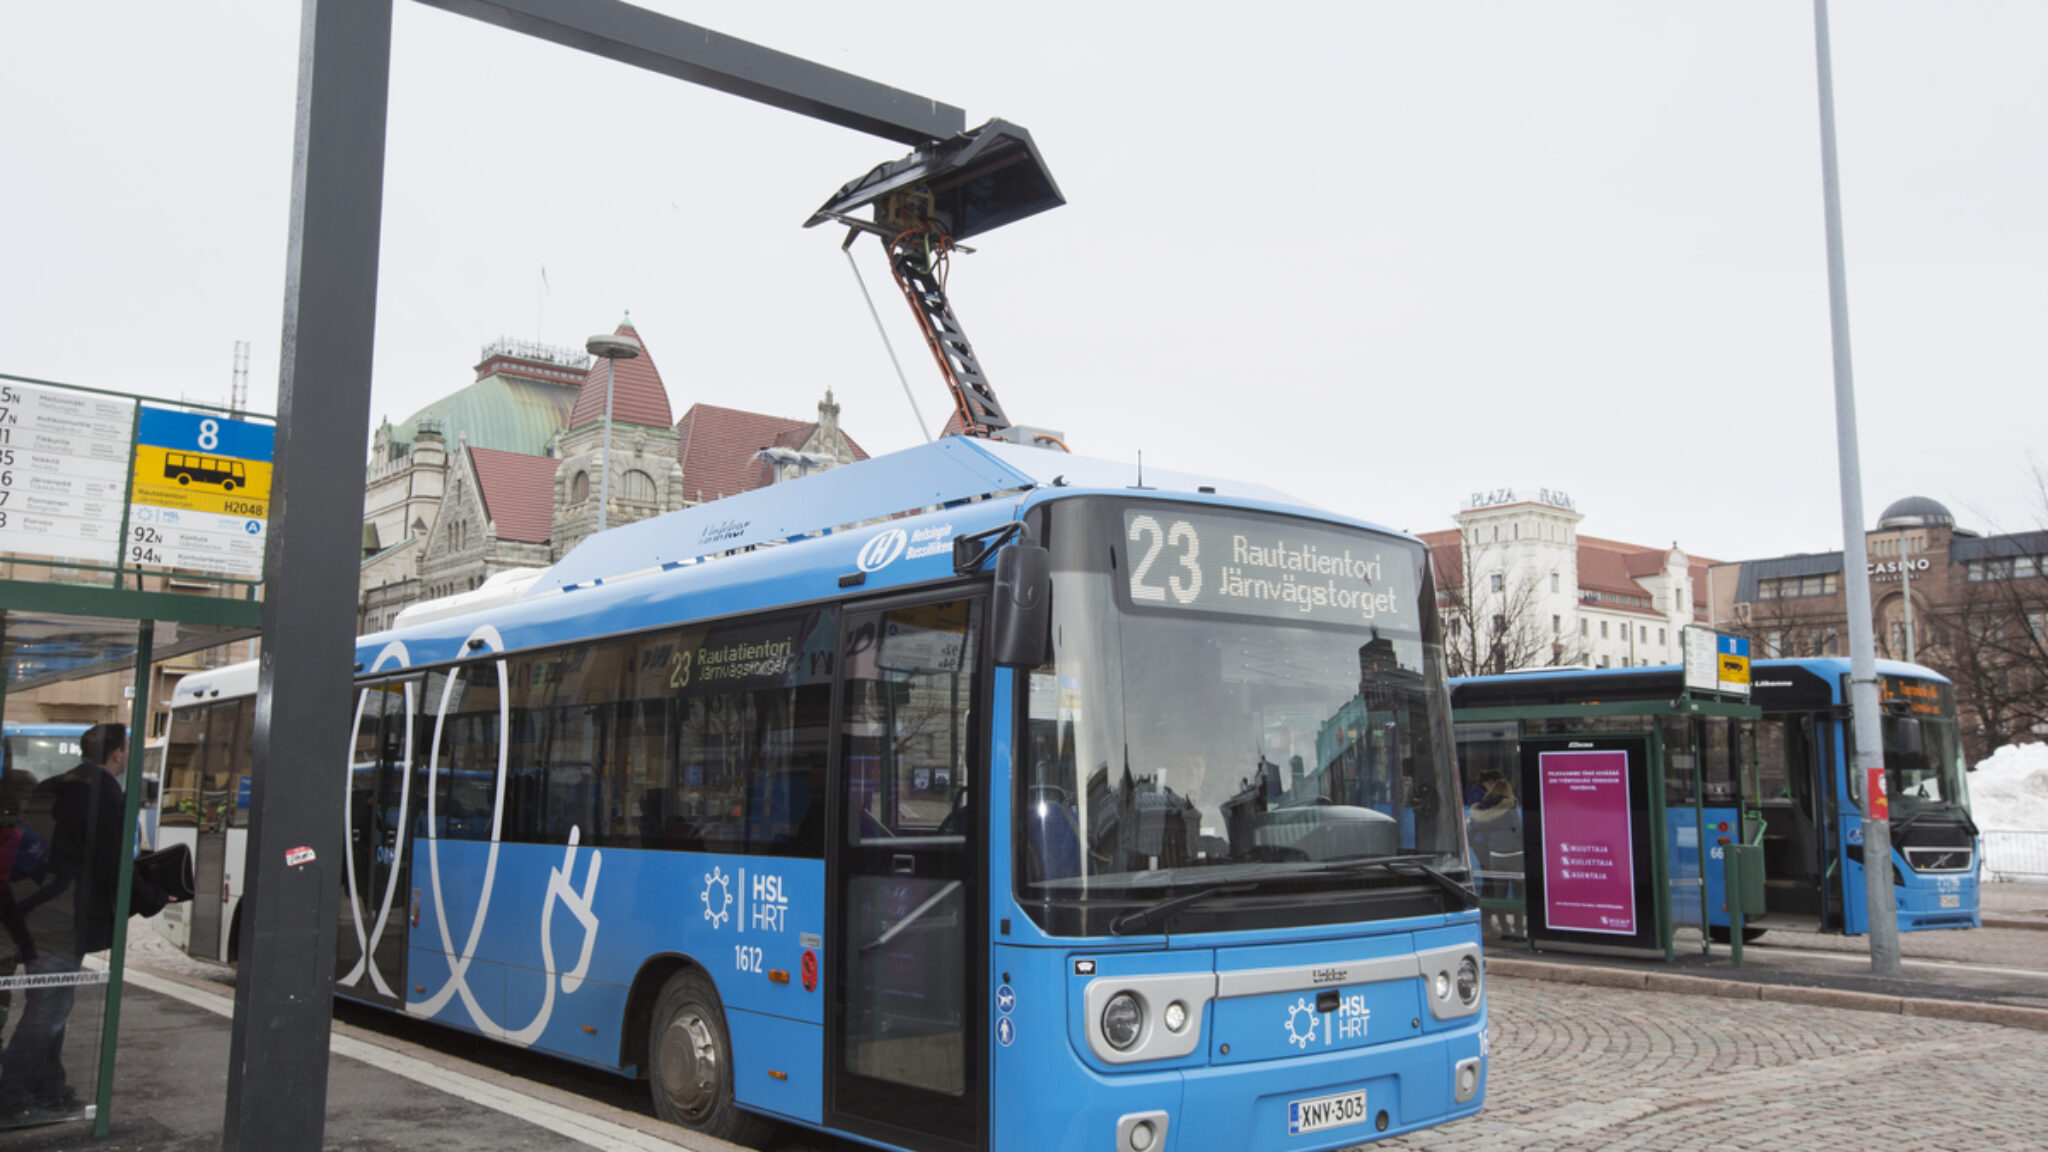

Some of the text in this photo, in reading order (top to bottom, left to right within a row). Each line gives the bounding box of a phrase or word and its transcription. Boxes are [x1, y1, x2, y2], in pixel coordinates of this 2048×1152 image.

[198, 419, 219, 450] 8
[224, 501, 264, 517] H2048
[1471, 487, 1571, 508] PLAZA PLAZA
[134, 526, 163, 544] 92N
[132, 546, 162, 563] 94N
[1128, 515, 1203, 604] 23
[1232, 534, 1382, 581] Rautatientori
[1866, 558, 1930, 576] CASINO
[1219, 566, 1398, 619] Järnvägstorget
[670, 650, 692, 689] 23
[697, 636, 792, 666] Rautatientori
[753, 874, 788, 904] HSL
[752, 902, 788, 933] HRT
[735, 944, 763, 974] 1612
[1339, 994, 1371, 1018] HSL
[1339, 1015, 1371, 1040] HRT
[1302, 1096, 1363, 1128] XNV-303
